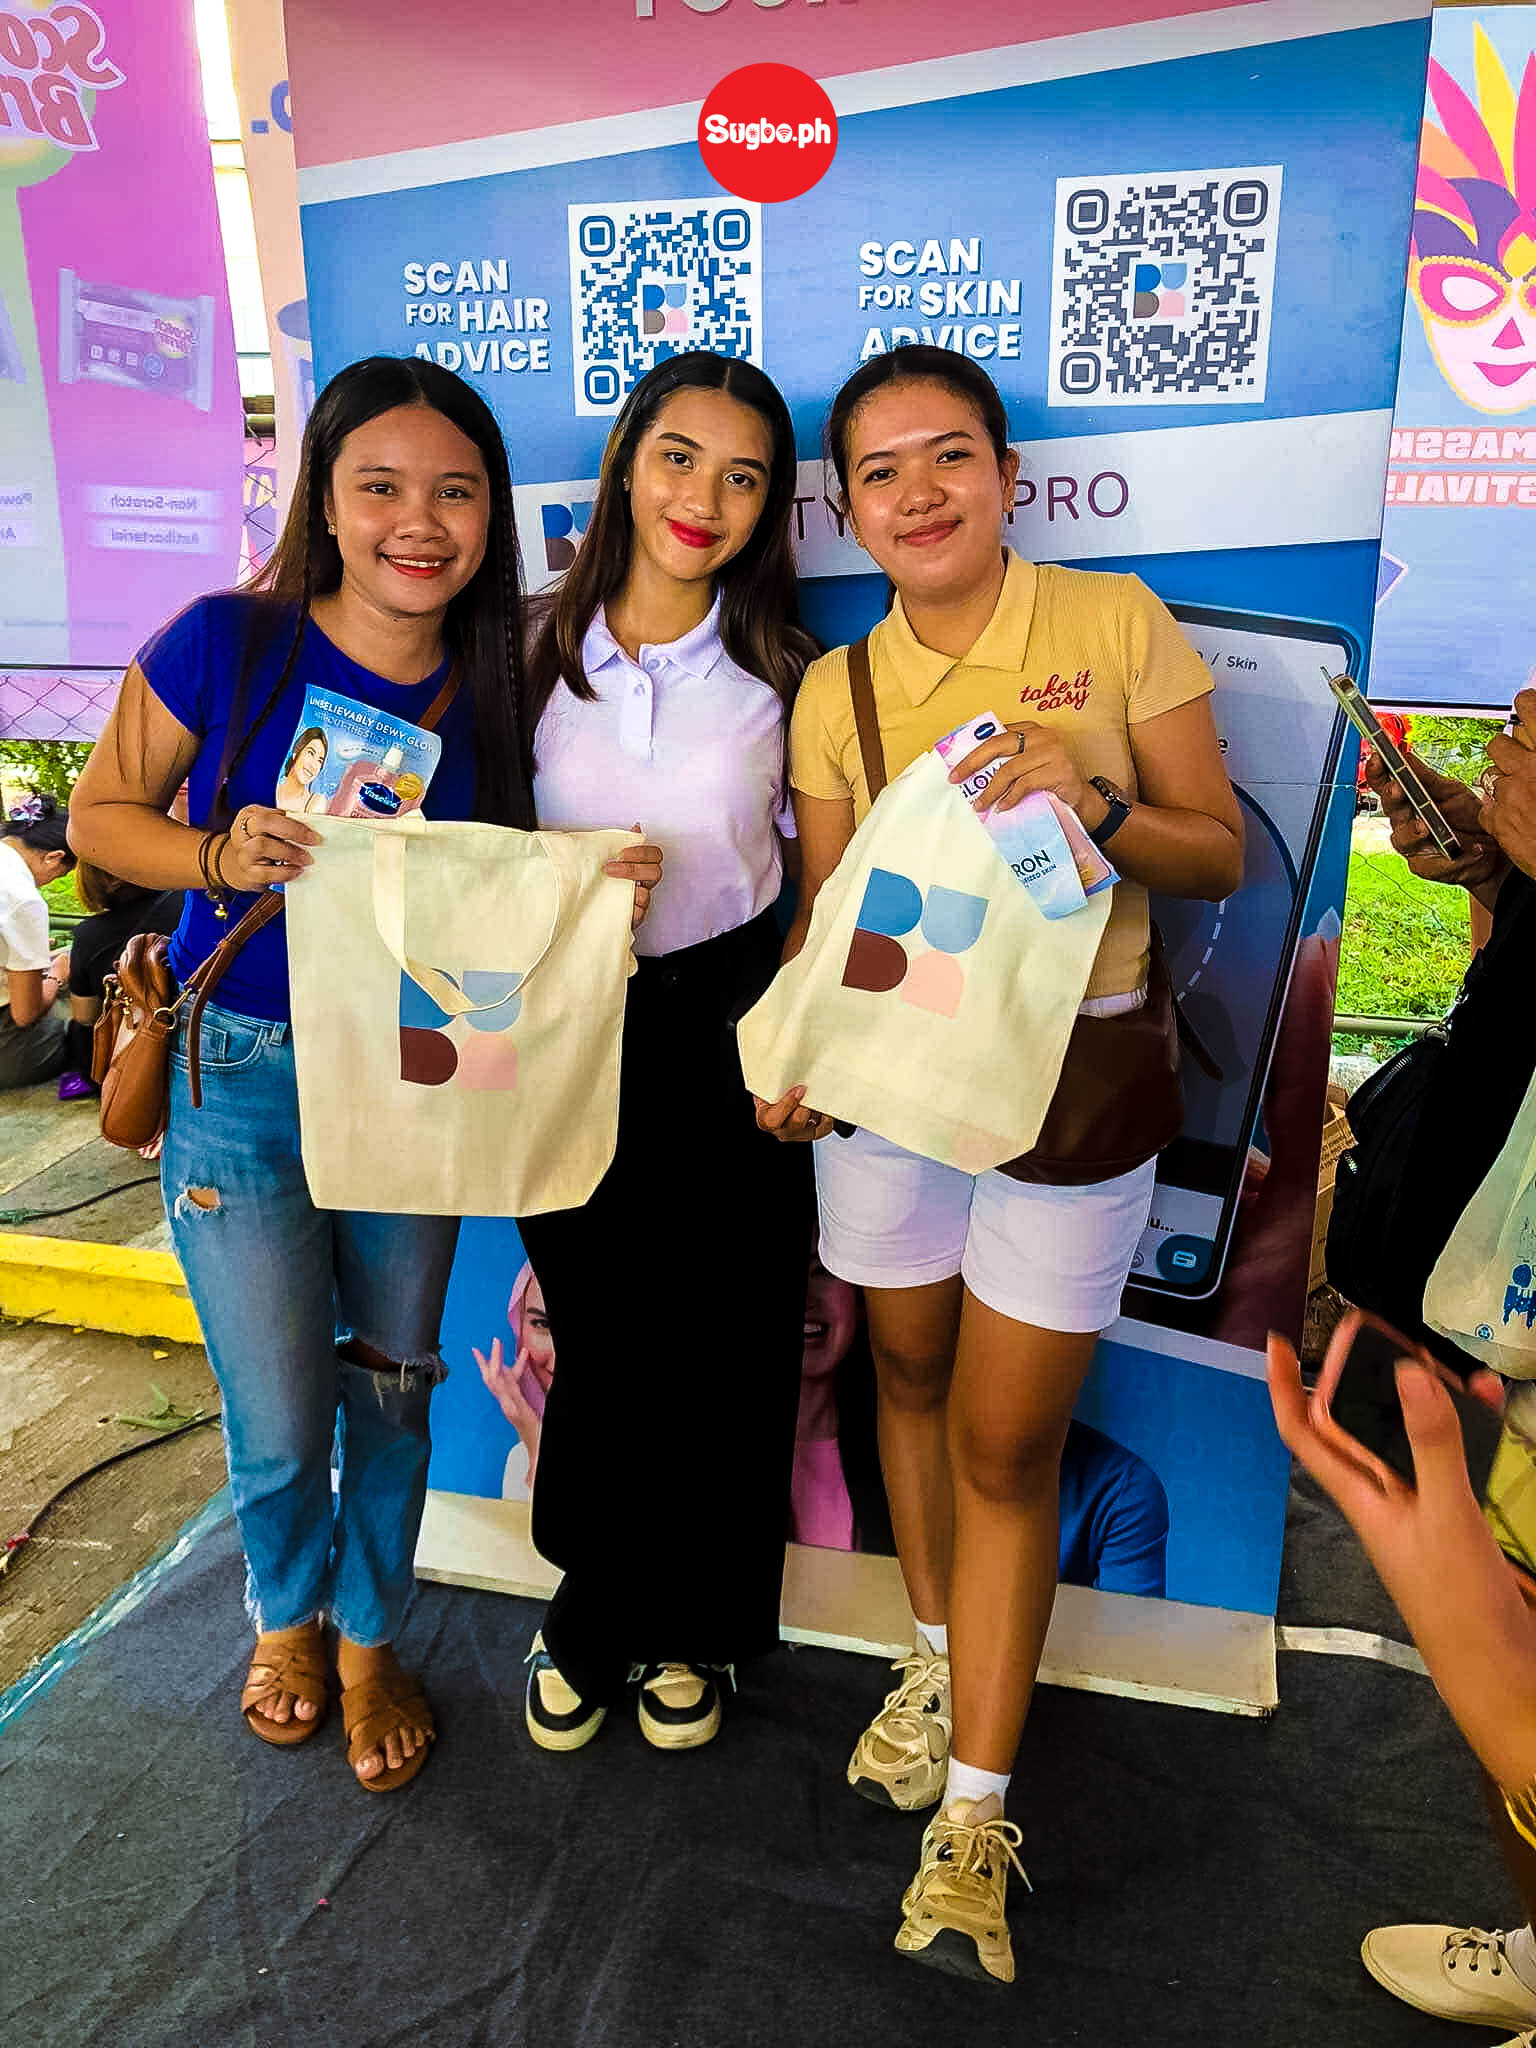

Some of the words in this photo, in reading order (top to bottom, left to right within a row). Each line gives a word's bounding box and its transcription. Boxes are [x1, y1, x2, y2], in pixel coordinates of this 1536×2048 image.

[859, 238, 981, 278] SCAN
[403, 259, 509, 295] SCAN
[405, 302, 453, 326] FOR
[459, 297, 550, 333] HAIR
[858, 284, 913, 310] FOR
[920, 279, 1022, 318] SKIN
[415, 338, 550, 372] ADVICE
[861, 323, 1022, 360] ADVICE
[1007, 471, 1129, 525] PRO
[1226, 655, 1258, 671] Skin
[1020, 674, 1071, 703] take
[1074, 669, 1093, 689] it
[1037, 689, 1090, 712] easy
[309, 695, 375, 728] UNBELIEVABLY
[375, 721, 404, 742] DEWY
